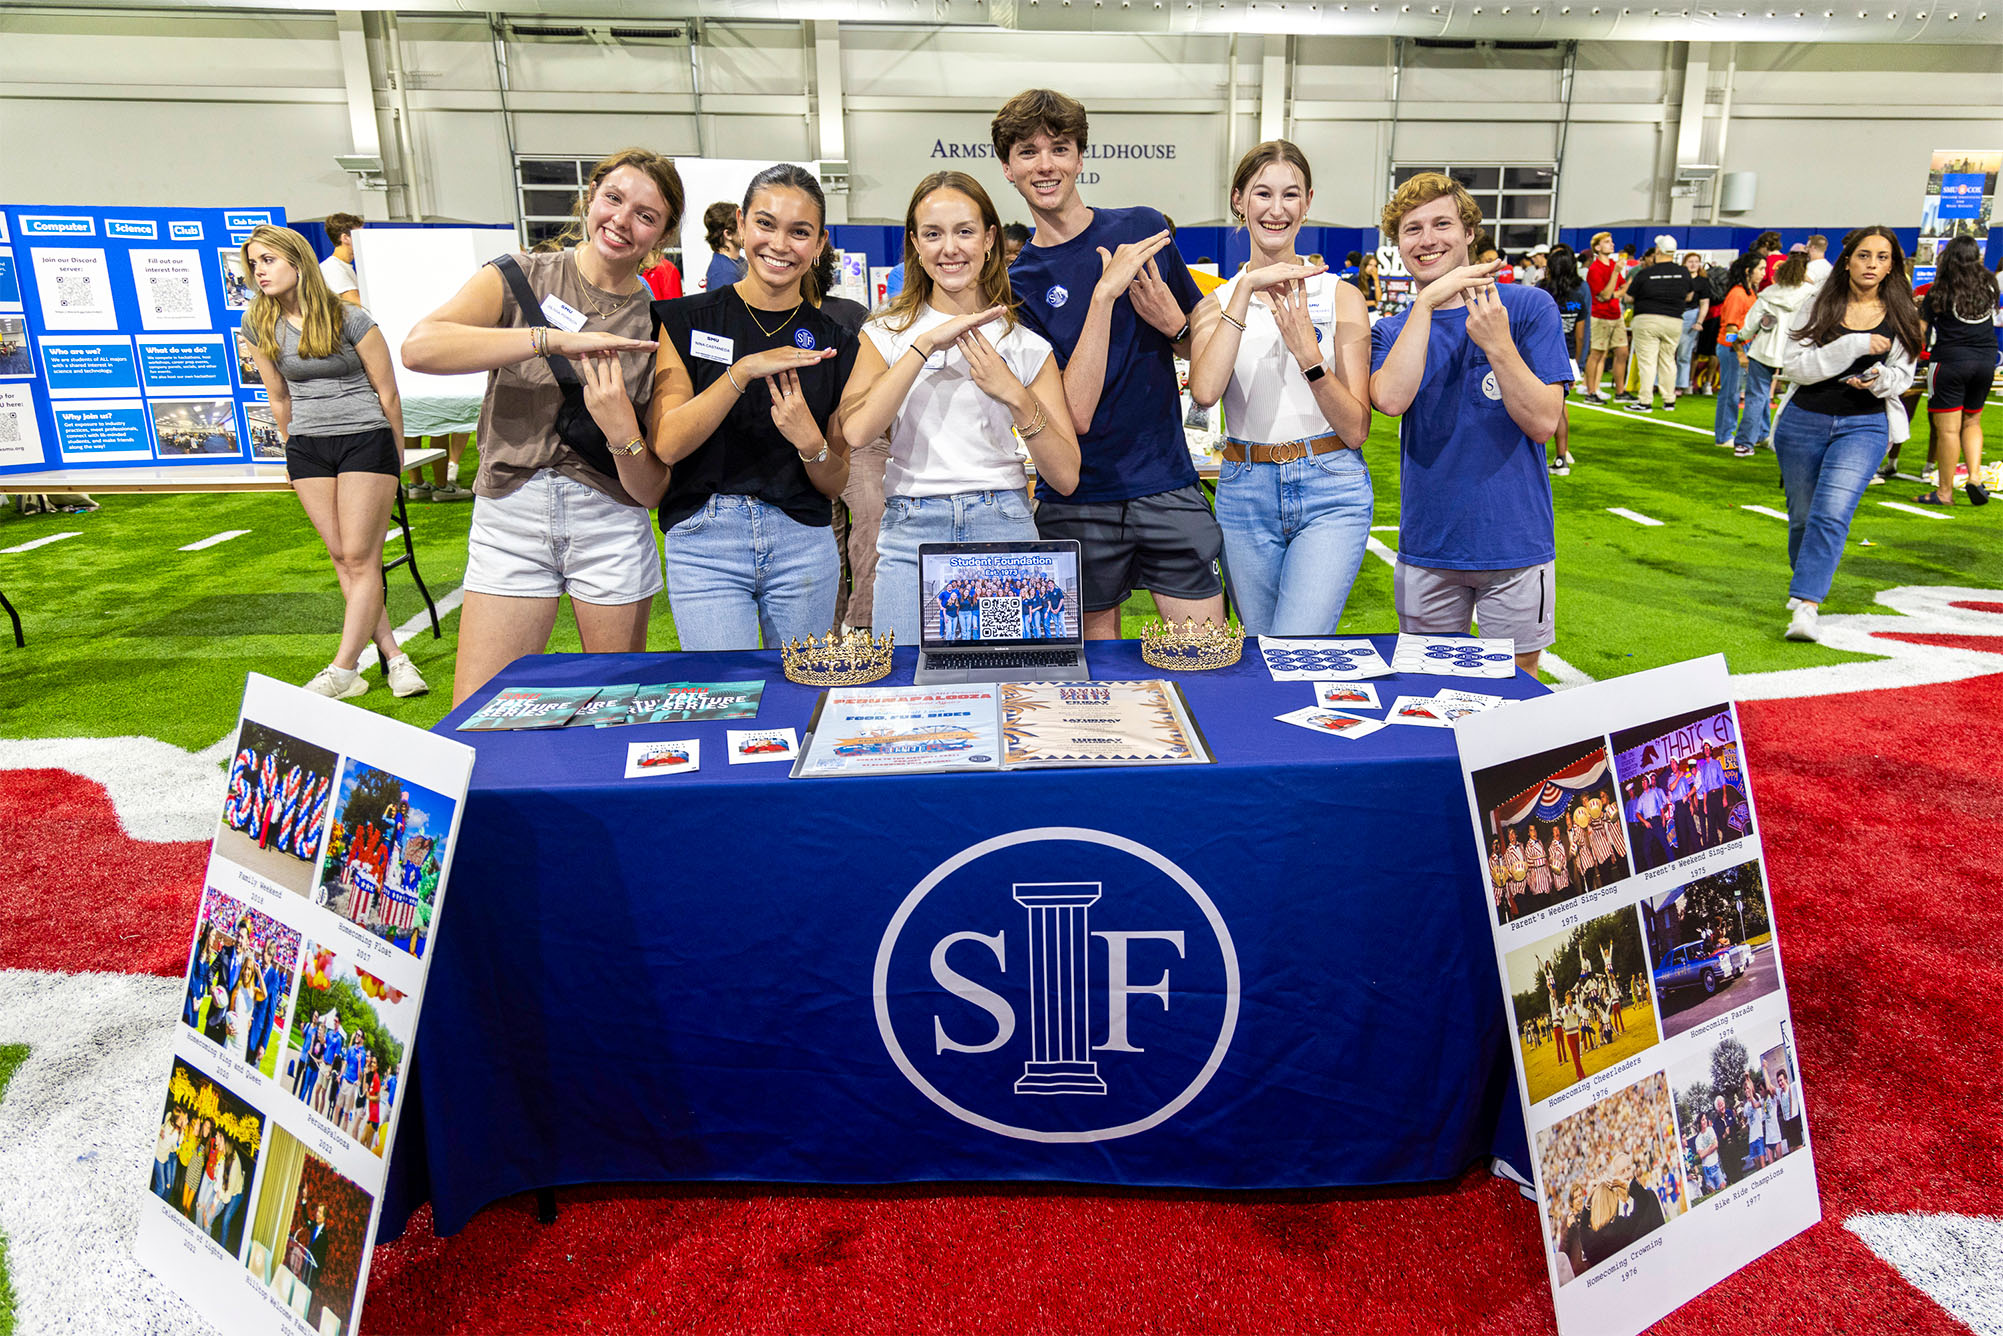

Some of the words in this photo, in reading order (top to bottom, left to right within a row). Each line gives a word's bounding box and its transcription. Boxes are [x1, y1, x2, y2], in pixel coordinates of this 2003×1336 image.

[930, 138, 995, 159] ARMST
[33, 221, 88, 233] Computer
[115, 223, 152, 234] Science
[174, 226, 199, 235] Club
[85, 347, 101, 355] we?
[61, 413, 82, 421] Why
[83, 413, 99, 421] join
[950, 557, 992, 567] Student
[993, 556, 1053, 566] Foundation
[499, 692, 543, 700] SMU
[1644, 864, 1676, 880] Parent's
[1678, 852, 1706, 867] Weekend
[1708, 840, 1743, 857] Sing-Song
[239, 871, 258, 888] Family
[1690, 866, 1706, 878] 1975
[1511, 912, 1545, 931] Parent's
[1547, 899, 1578, 916] Weekend
[1580, 885, 1618, 904] Sing-Song
[1561, 914, 1578, 927] 1975
[338, 921, 372, 949] Homecoming
[374, 941, 392, 958] Float
[1690, 1016, 1729, 1039] Homecoming
[1731, 1005, 1754, 1020] Parade
[1719, 1027, 1735, 1039] 1976
[186, 1031, 217, 1058] Homecoming
[219, 1052, 232, 1067] King
[234, 1063, 244, 1074] and
[1548, 1081, 1591, 1108] Homecoming
[1593, 1057, 1642, 1084] Cheerleaders
[1592, 1087, 1609, 1102] 1976
[1714, 1197, 1730, 1211] Bike
[1732, 1187, 1748, 1200] Ride
[1750, 1168, 1784, 1190] Champions
[1746, 1193, 1761, 1207] 1977
[1586, 1258, 1628, 1288] Homecoming
[1630, 1237, 1663, 1260] Crowning
[1621, 1266, 1638, 1282] 1976
